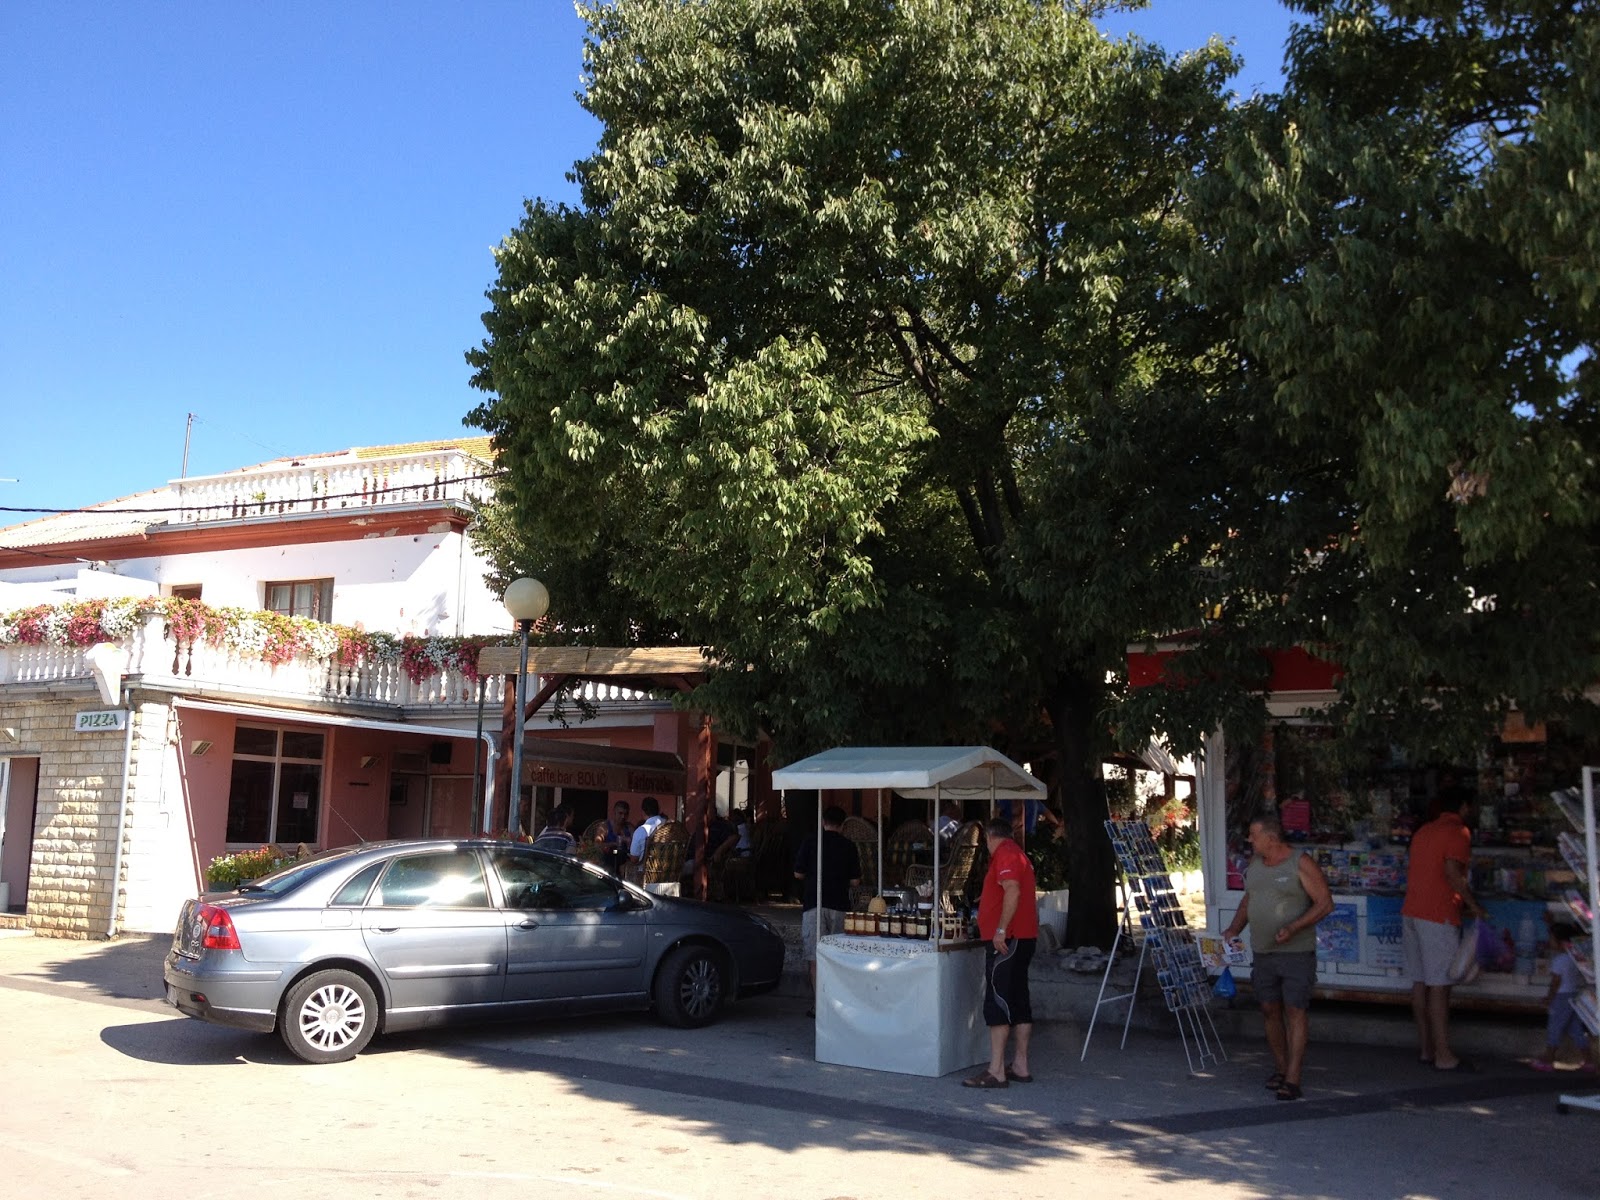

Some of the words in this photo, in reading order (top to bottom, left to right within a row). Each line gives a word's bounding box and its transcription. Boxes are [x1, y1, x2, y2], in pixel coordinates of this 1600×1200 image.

[80, 713, 118, 727] PIZZA
[531, 768, 555, 783] caffe
[557, 769, 573, 784] bar
